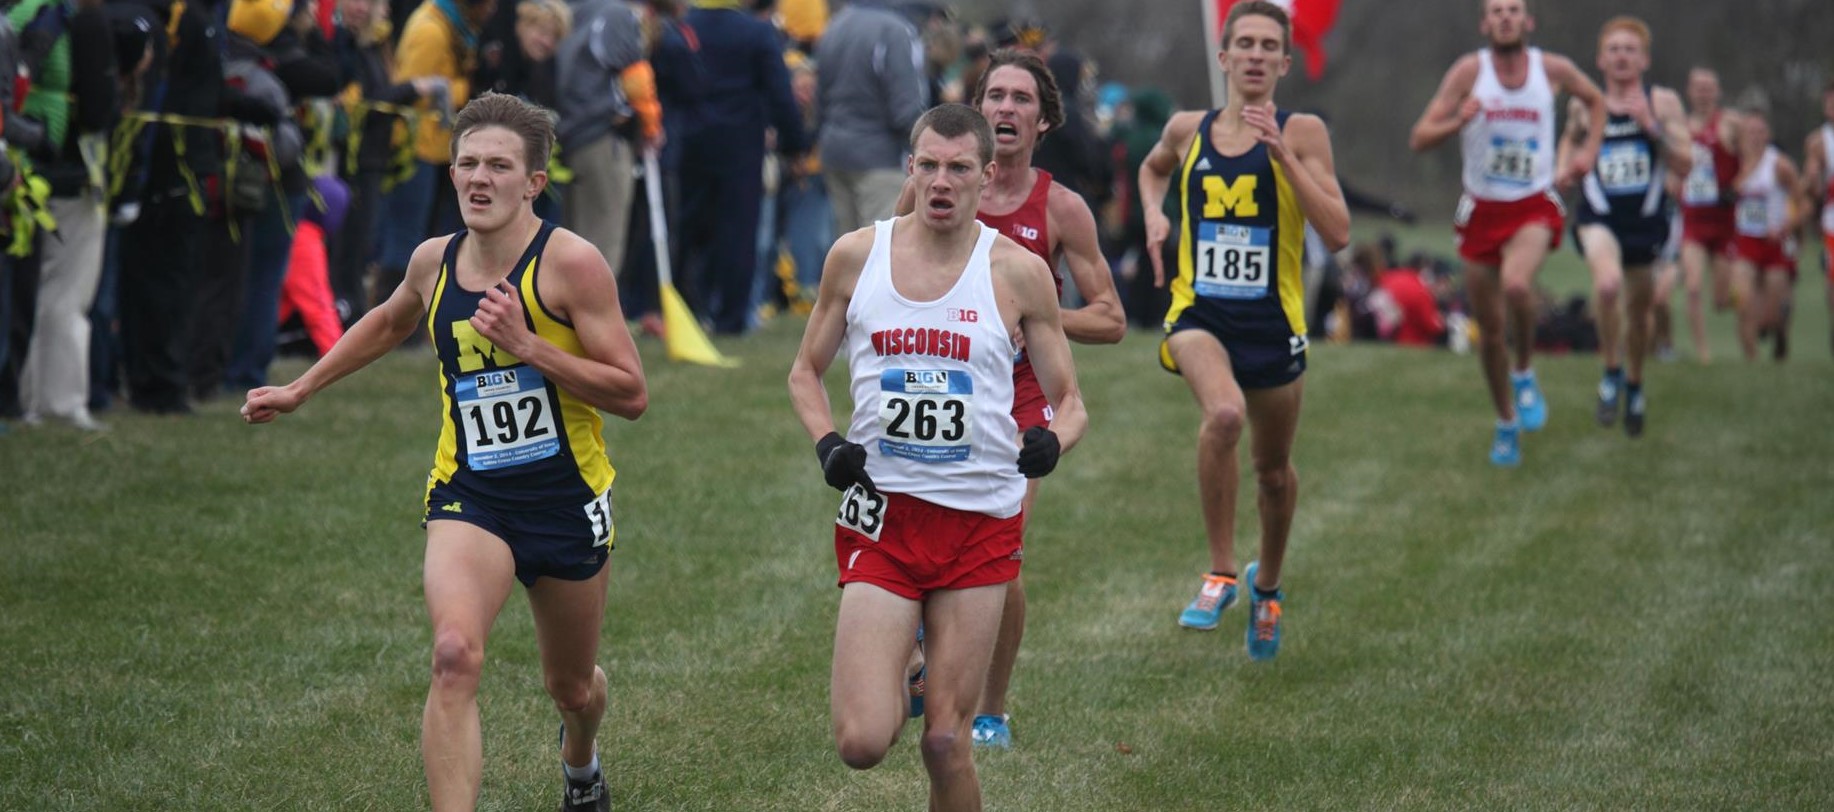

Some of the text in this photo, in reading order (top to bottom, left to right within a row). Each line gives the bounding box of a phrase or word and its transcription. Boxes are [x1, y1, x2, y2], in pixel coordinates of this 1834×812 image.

[1202, 174, 1259, 219] M
[1205, 247, 1262, 282] 185
[871, 328, 971, 363] WISCONSIN
[470, 396, 549, 447] 192
[886, 398, 965, 442] 263
[838, 485, 884, 534] 63
